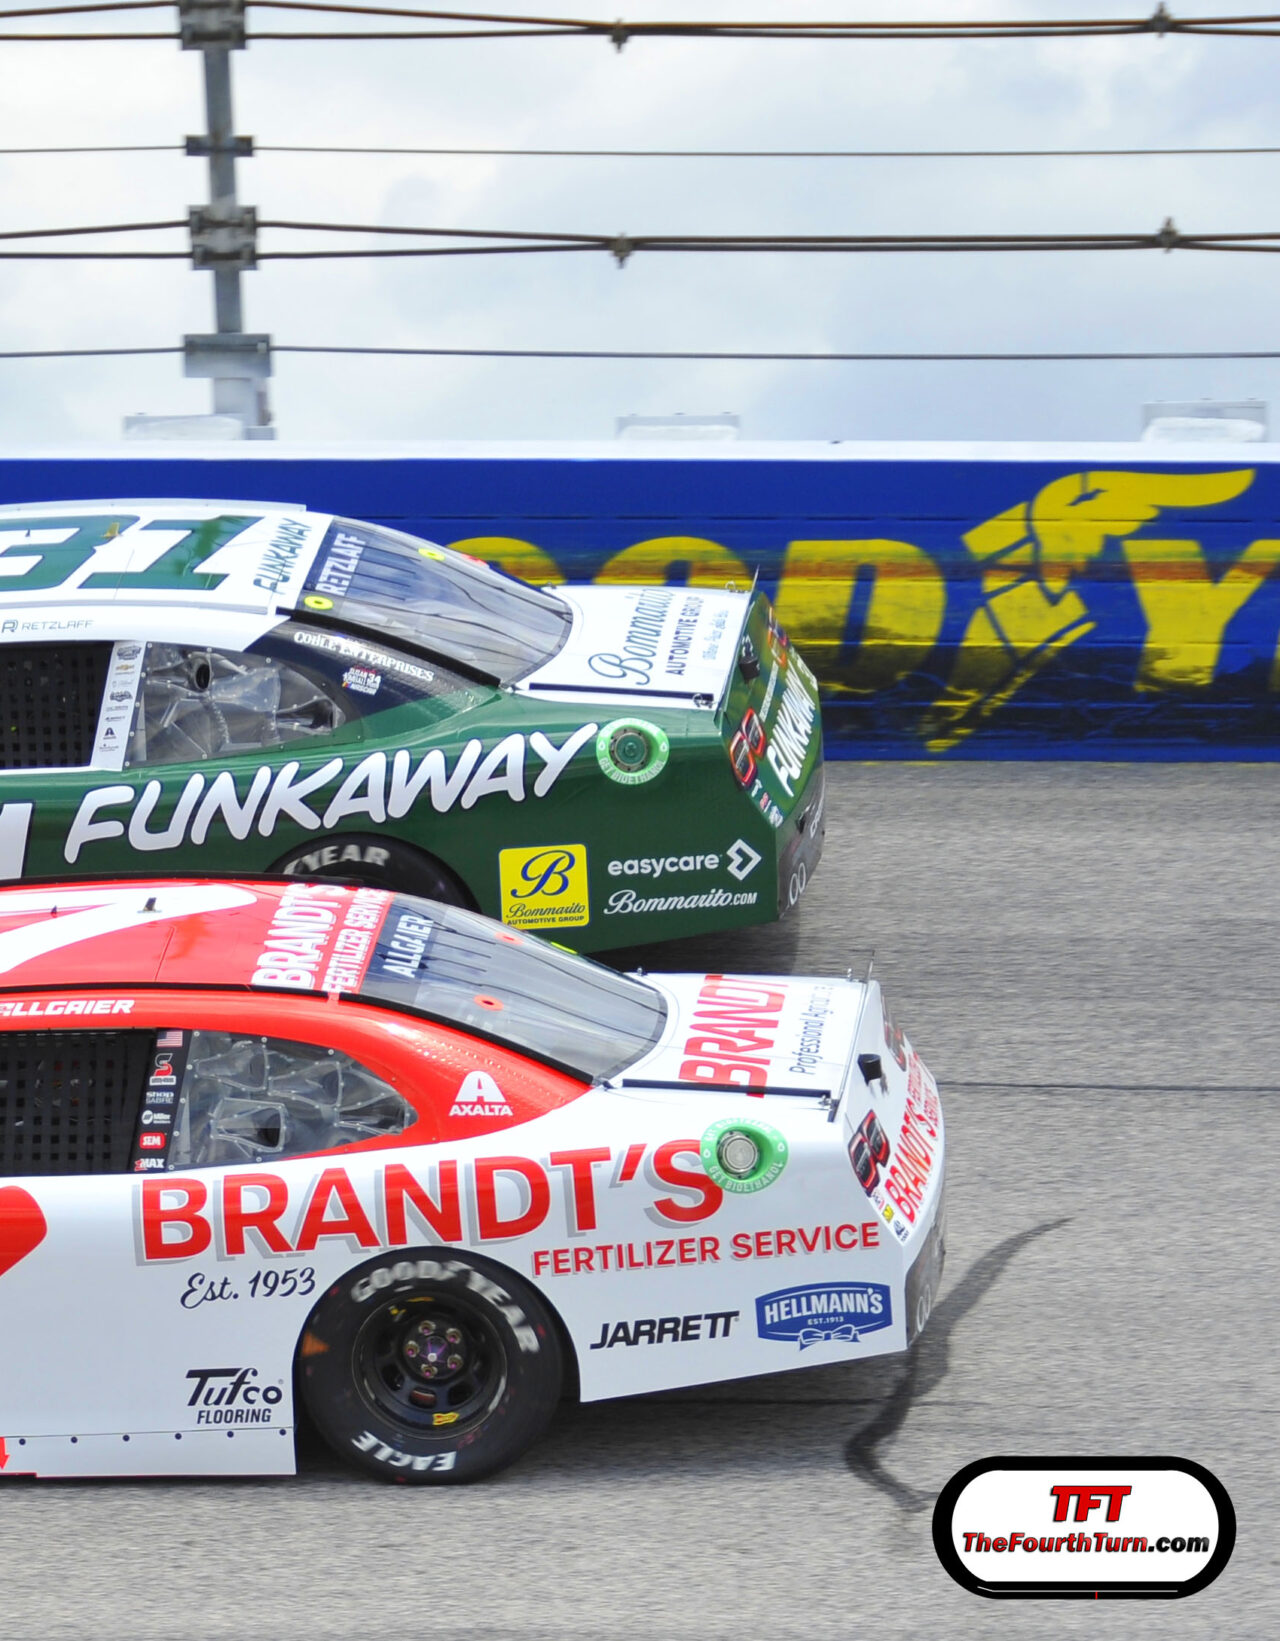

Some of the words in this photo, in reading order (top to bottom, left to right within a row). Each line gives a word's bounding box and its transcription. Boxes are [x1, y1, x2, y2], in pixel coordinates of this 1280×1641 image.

[253, 517, 312, 595] FUNKAWAY
[315, 532, 367, 597] RETZLAFF
[21, 619, 95, 631] RETZLAFF
[588, 588, 676, 686] Bommarito
[293, 630, 337, 651] COBLE
[338, 638, 435, 682] ENTERPRISES
[665, 618, 698, 676] AUTOMOTIVE
[65, 722, 599, 864] FUNKAWAY
[607, 852, 720, 878] easycare
[505, 902, 586, 919] Bommarito
[506, 916, 557, 926] AUTOMOTIVE
[558, 914, 585, 923] GROUP
[321, 927, 373, 994] FERTILIZER
[382, 914, 434, 979] ALLGAIER
[448, 1103, 514, 1117] AXALTA
[142, 1135, 162, 1146] SEM
[709, 1165, 726, 1183] GET
[724, 1161, 784, 1192] BIOETHANOL
[135, 1138, 724, 1262] BRANDT'S
[532, 1235, 721, 1277] FERTILIZER
[729, 1221, 881, 1260] SERVICE
[180, 1272, 239, 1310] Est.
[248, 1266, 316, 1298] 1953
[763, 1287, 884, 1326] HELLMANN'S
[589, 1310, 740, 1350] JARRETT
[185, 1367, 283, 1407] Tufco
[196, 1408, 272, 1425] FLOORING
[351, 1430, 457, 1471] EAGLE
